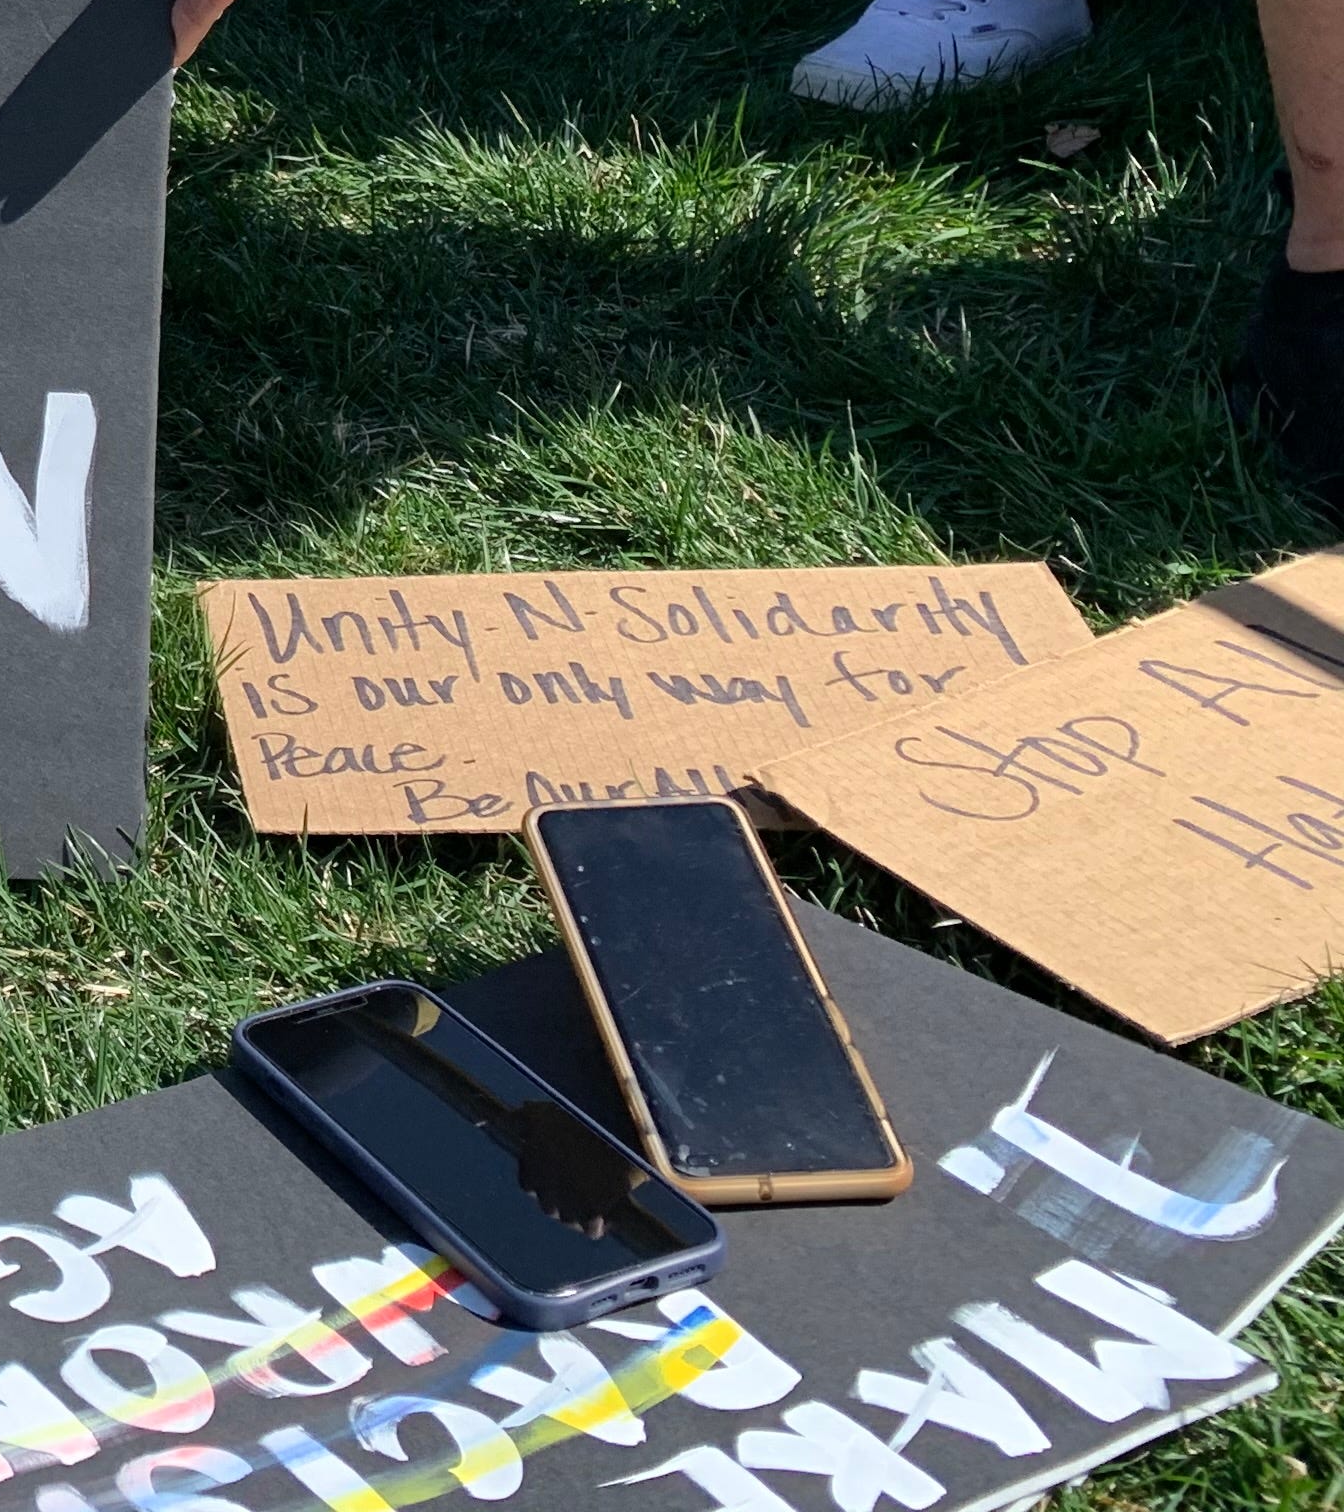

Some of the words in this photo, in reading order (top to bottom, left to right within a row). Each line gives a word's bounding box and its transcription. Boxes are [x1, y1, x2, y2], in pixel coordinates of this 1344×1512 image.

[495, 661, 634, 720] only
[647, 671, 811, 728] way
[825, 650, 968, 702] for
[393, 778, 515, 826] Be
[35, 1288, 802, 1512] RACIS
